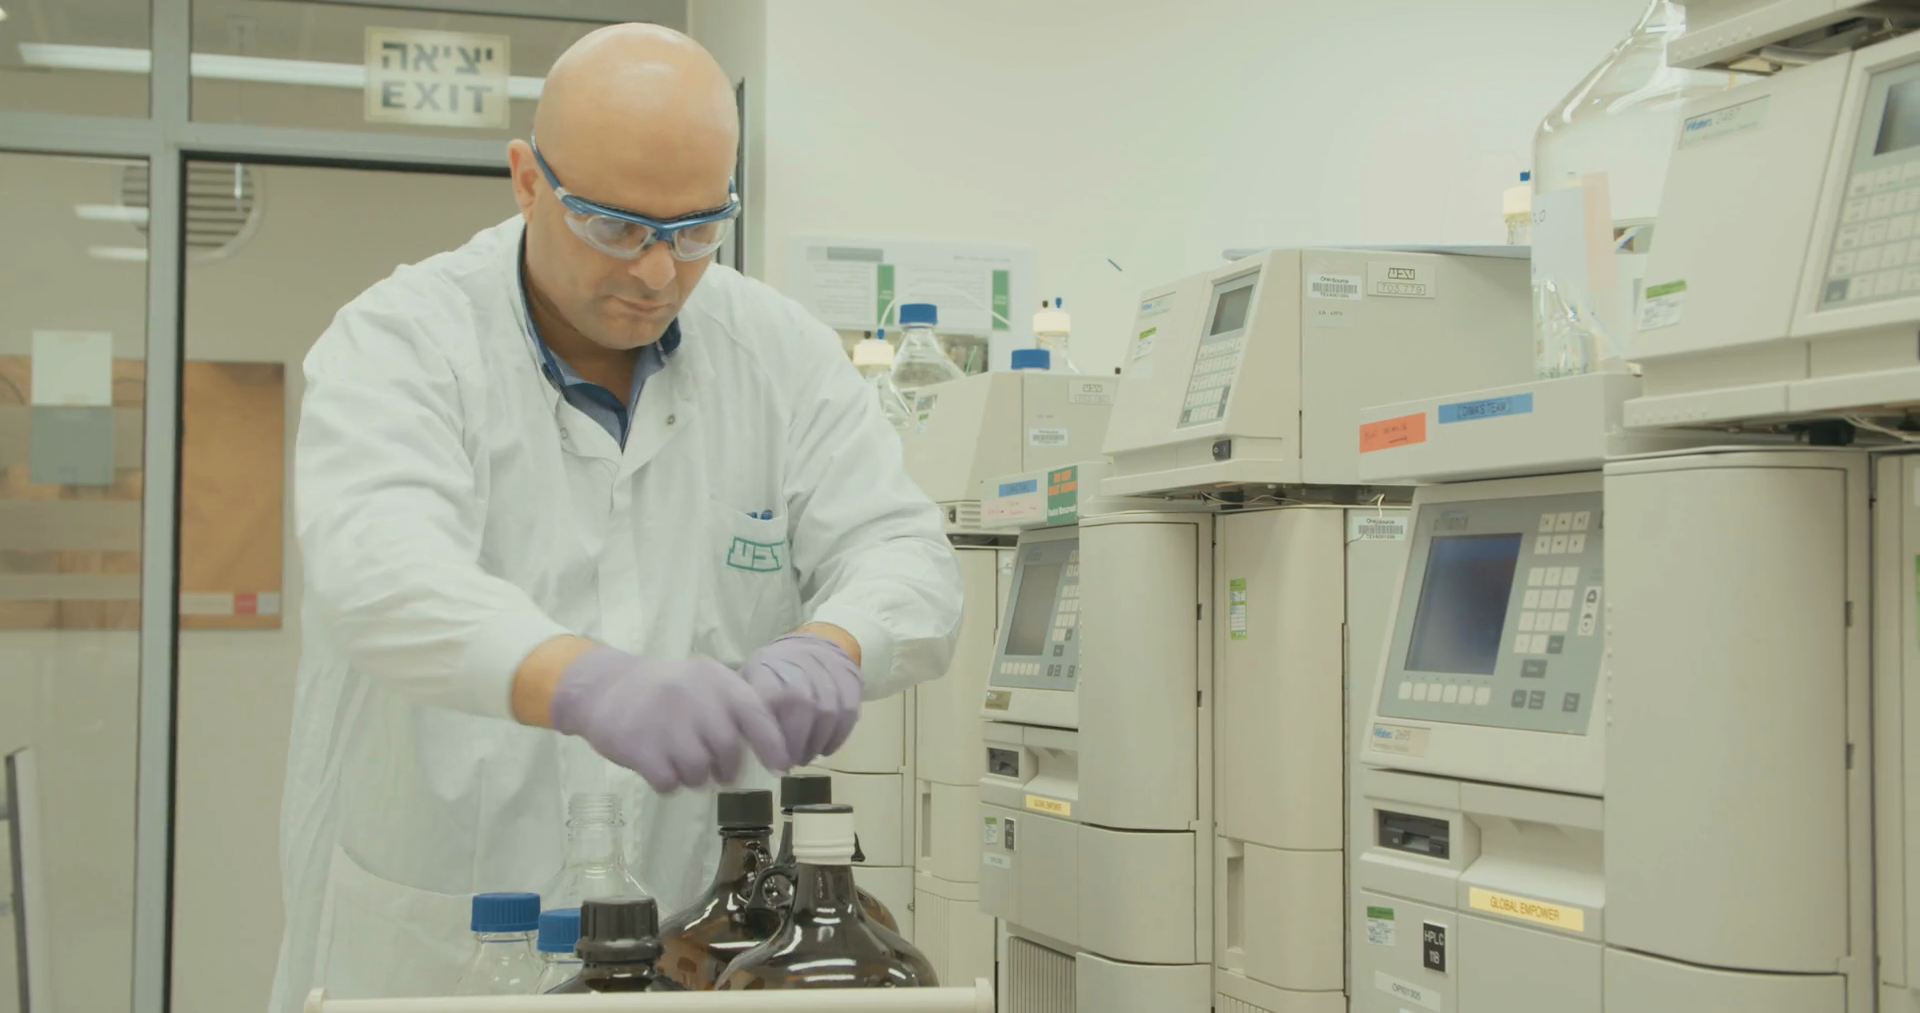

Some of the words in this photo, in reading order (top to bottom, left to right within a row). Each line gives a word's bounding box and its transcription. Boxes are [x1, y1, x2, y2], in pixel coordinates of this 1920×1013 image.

[381, 42, 494, 75] יציאה
[381, 79, 493, 114] EXIT
[1487, 401, 1508, 413] TEAM
[1489, 895, 1518, 913] GLOBAL
[1520, 903, 1560, 920] EMPOWER
[1424, 930, 1444, 946] HPLC
